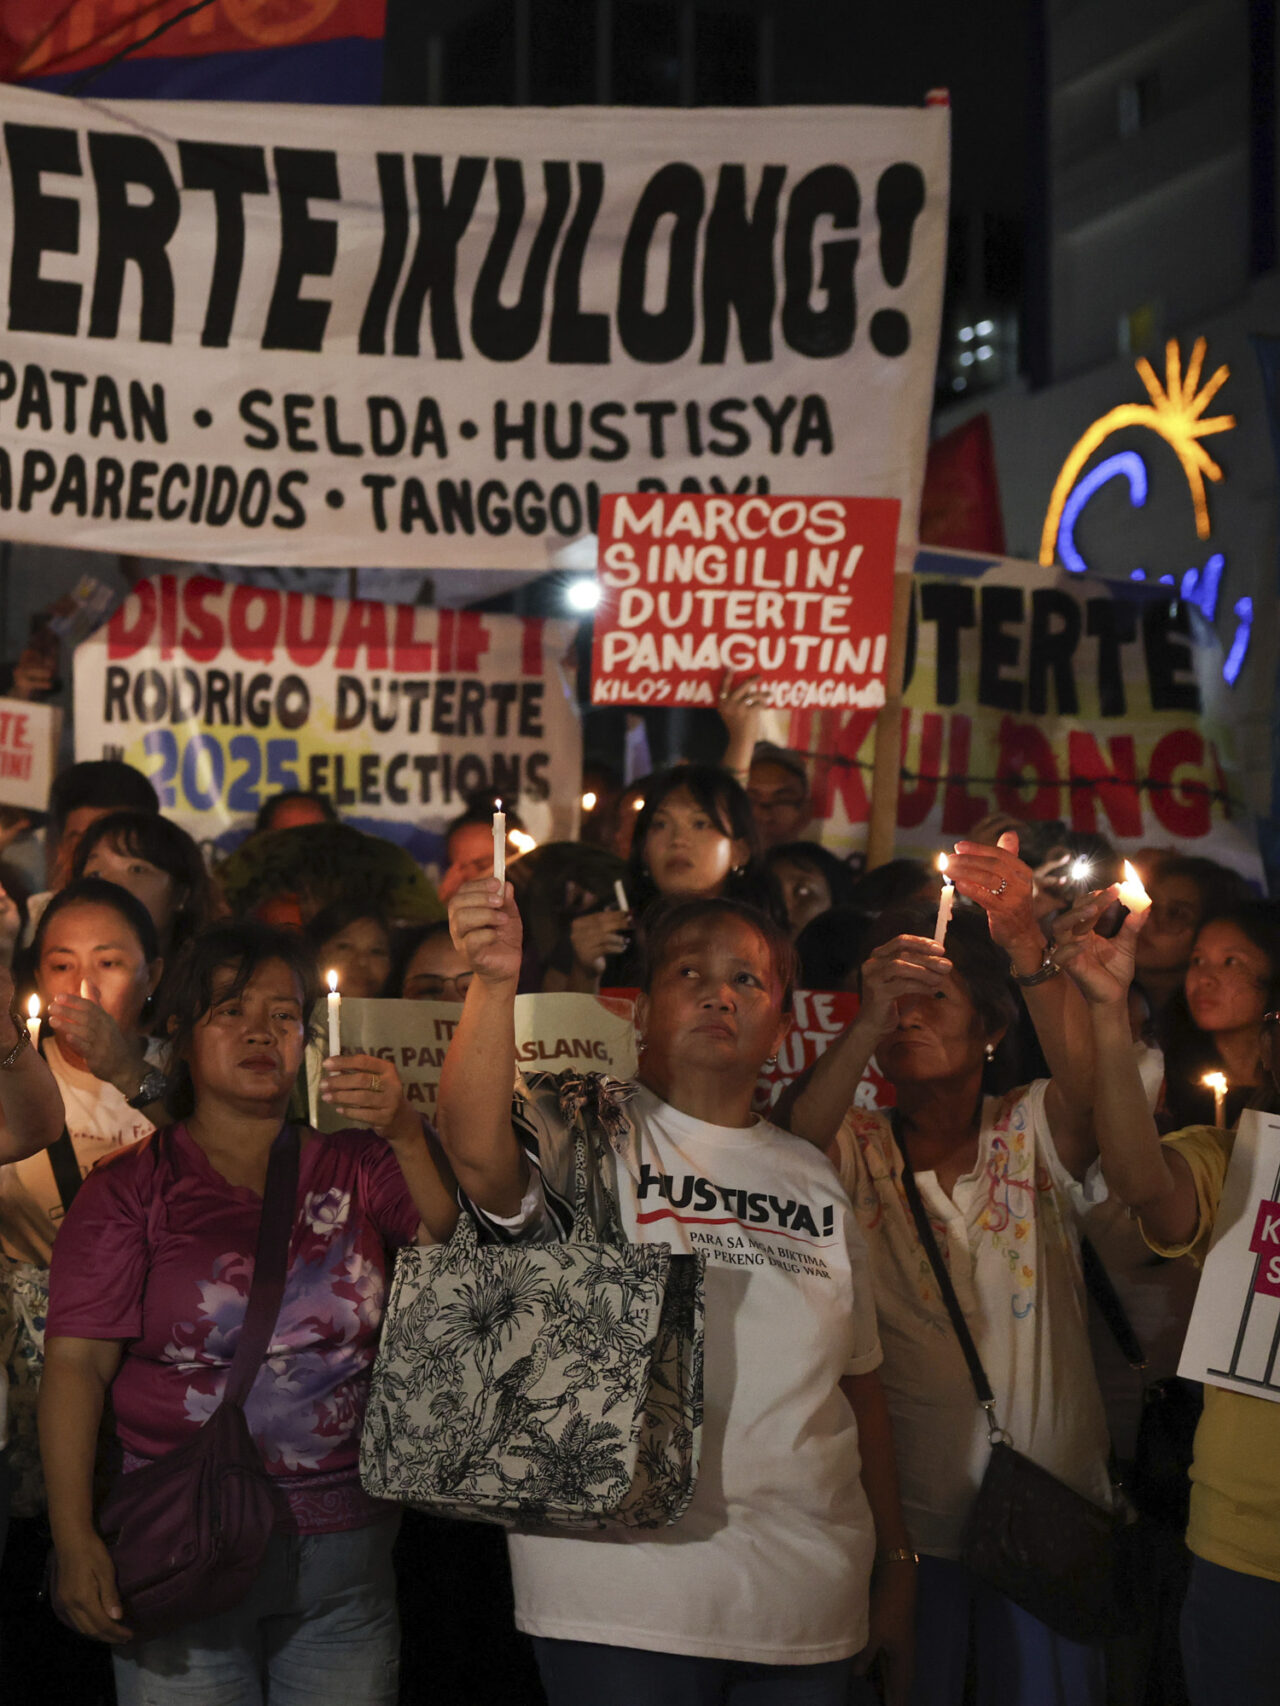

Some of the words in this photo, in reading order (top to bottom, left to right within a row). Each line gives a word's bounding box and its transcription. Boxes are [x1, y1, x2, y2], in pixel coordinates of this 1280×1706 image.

[358, 152, 926, 365] IKULONG!
[238, 389, 448, 458] SELDA
[493, 394, 834, 461] HUSTISYA
[612, 496, 847, 545] MARCOS
[602, 543, 864, 594] SINGILIN!
[617, 587, 853, 633] DUTERTE
[104, 666, 311, 730] RODRIGO
[336, 676, 545, 738] DUTERTE
[592, 678, 672, 703] KILOS
[675, 680, 715, 704] NA
[144, 729, 300, 813] 2025
[309, 752, 551, 807] ELECTIONS
[637, 1164, 834, 1238] HUSTISYA!
[690, 1231, 723, 1249] PARA
[727, 1236, 745, 1250] SA
[778, 1247, 827, 1269] BIKTIMA
[714, 1249, 765, 1267] PEKENG
[803, 1265, 832, 1280] WAR
